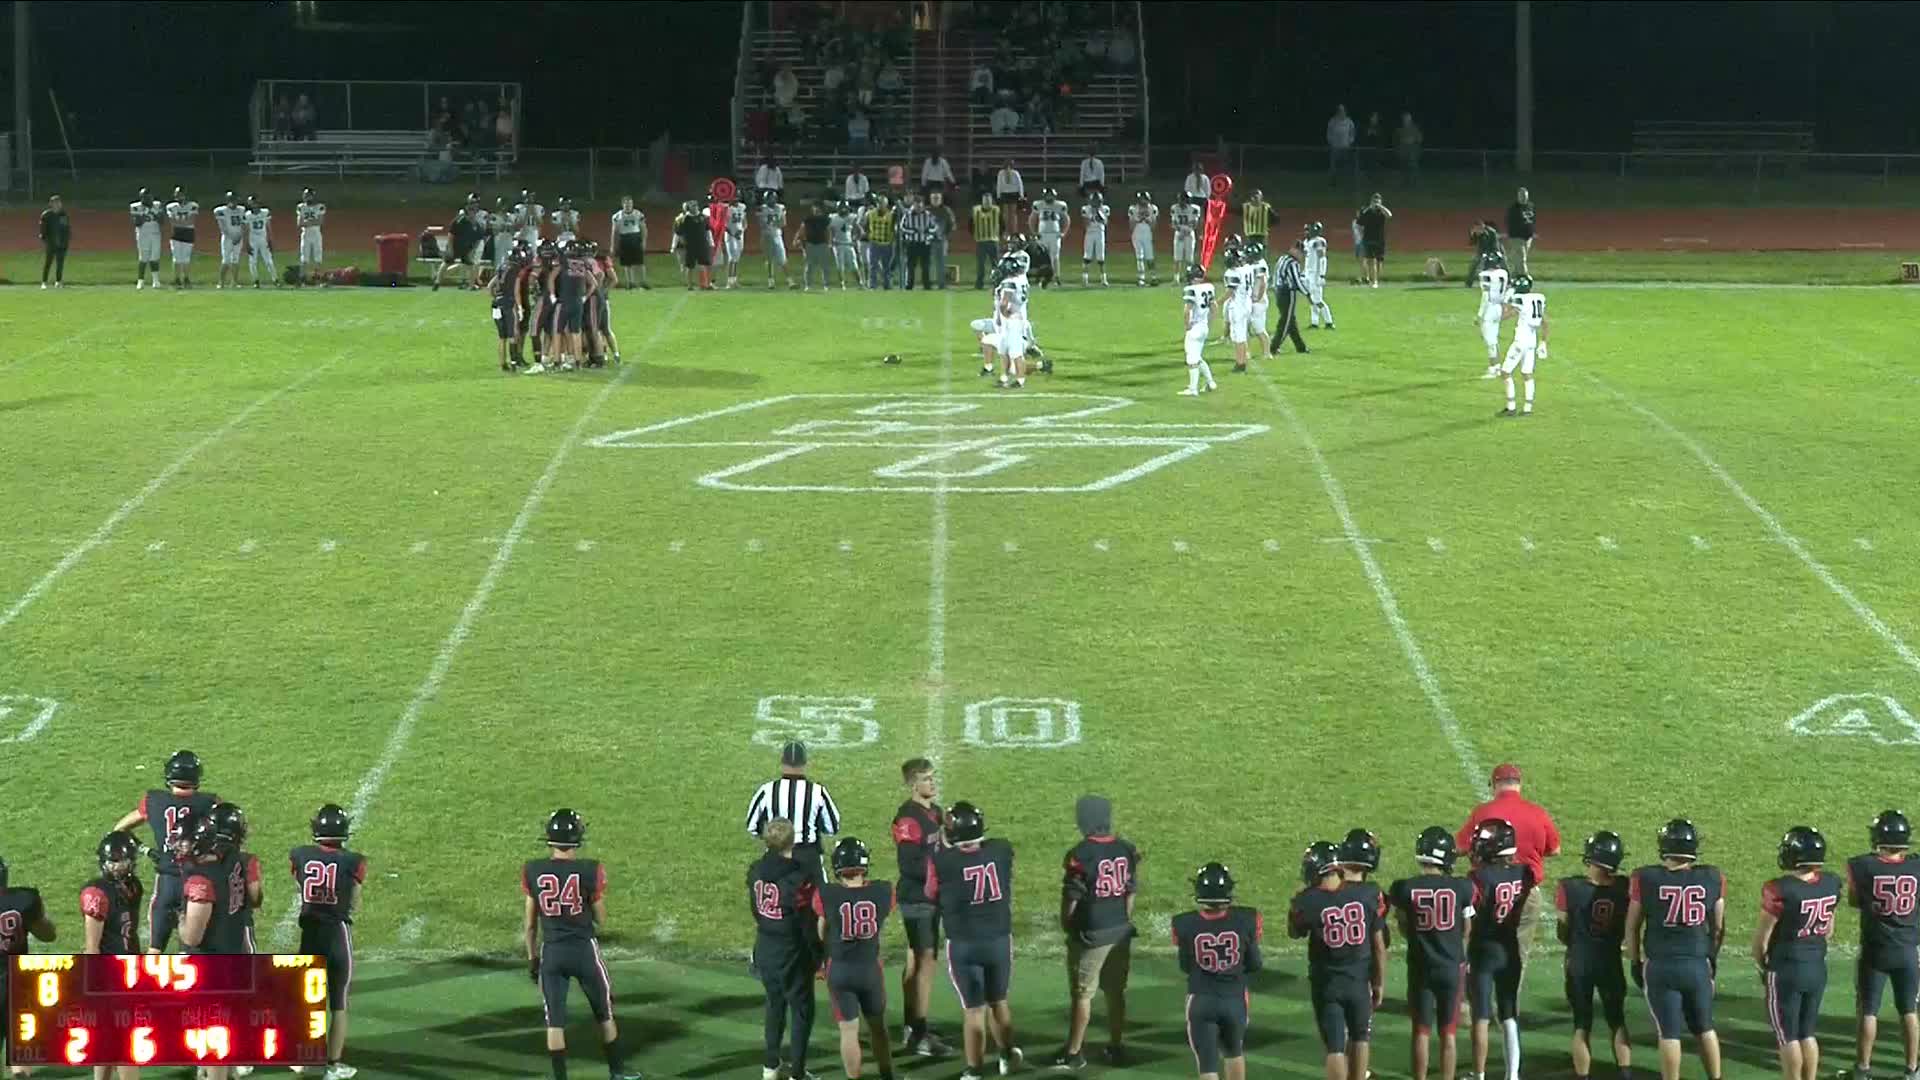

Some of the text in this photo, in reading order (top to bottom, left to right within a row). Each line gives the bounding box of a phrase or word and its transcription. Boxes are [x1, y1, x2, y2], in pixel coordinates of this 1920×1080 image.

[1531, 299, 1543, 319] 10
[303, 860, 338, 905] 21
[536, 873, 583, 917] 24
[964, 862, 1002, 905] 71
[1095, 856, 1130, 898] 60
[1872, 875, 1919, 917] 58
[754, 879, 783, 920] 12
[839, 900, 879, 941] 18
[1411, 888, 1456, 931] 50
[1659, 884, 1706, 928] 76
[1798, 895, 1838, 938] 75
[1321, 901, 1366, 948] 68
[1194, 930, 1241, 972] 63
